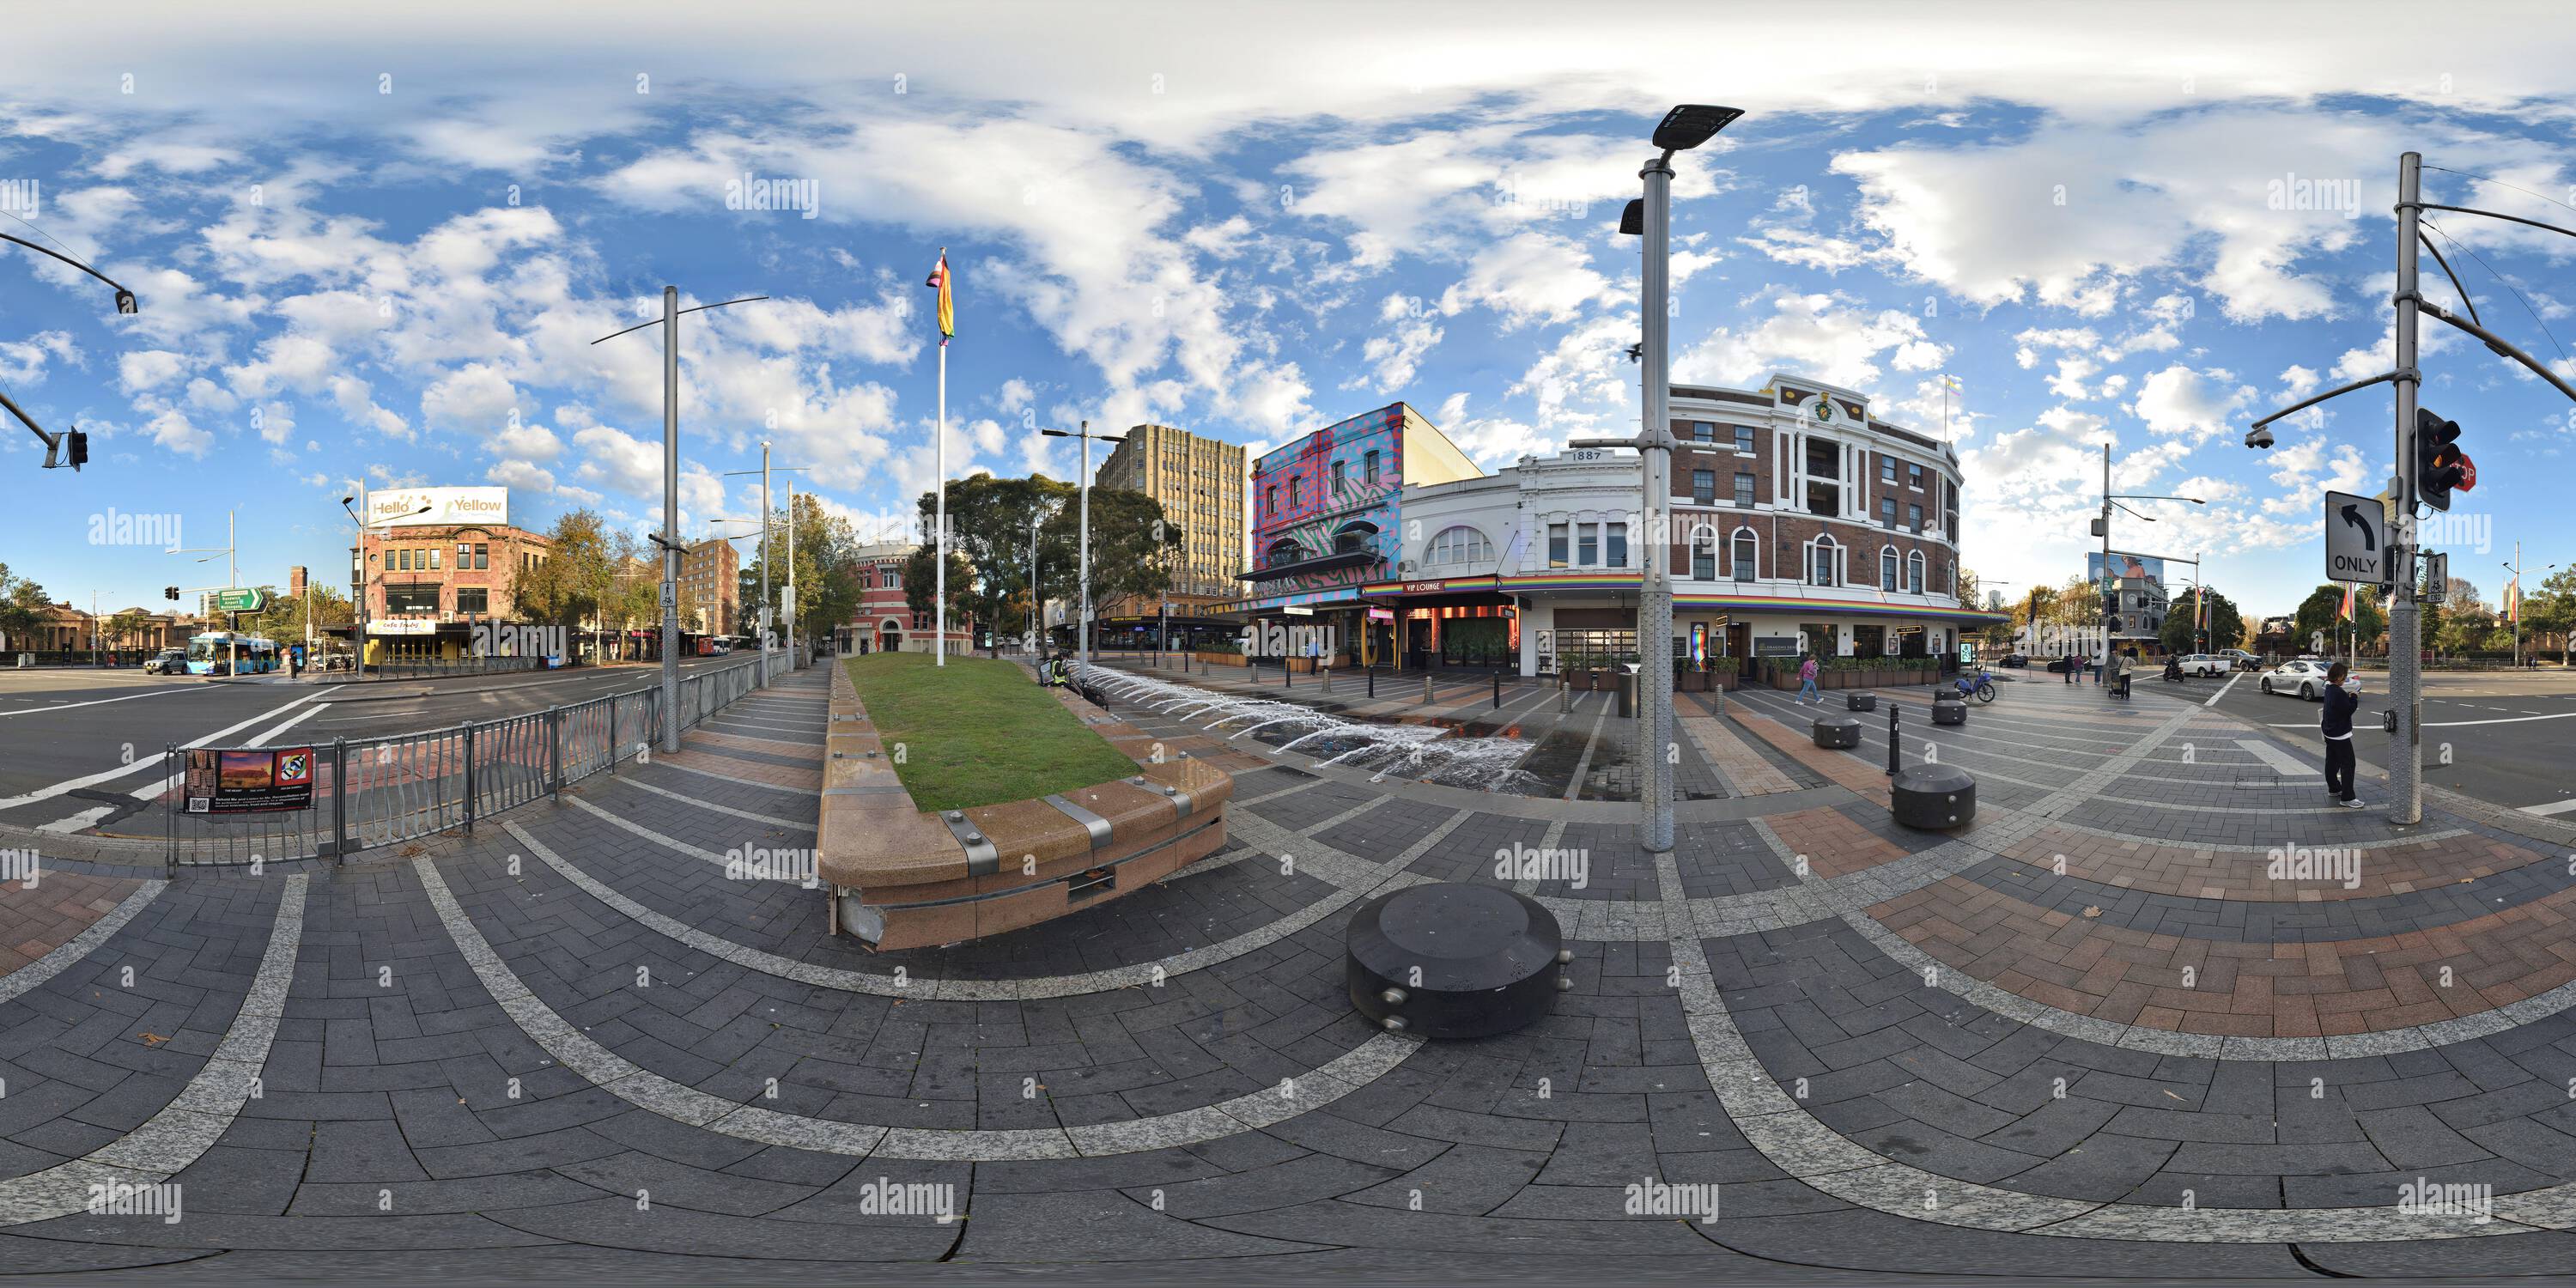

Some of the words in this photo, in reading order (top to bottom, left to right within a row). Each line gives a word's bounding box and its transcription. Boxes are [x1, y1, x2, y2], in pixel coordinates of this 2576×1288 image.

[1573, 451, 1601, 461] 1887
[374, 501, 409, 514] Hello
[455, 500, 501, 511] Yellow
[2335, 555, 2378, 574] ONLY
[1417, 582, 1440, 592] LOUNGE
